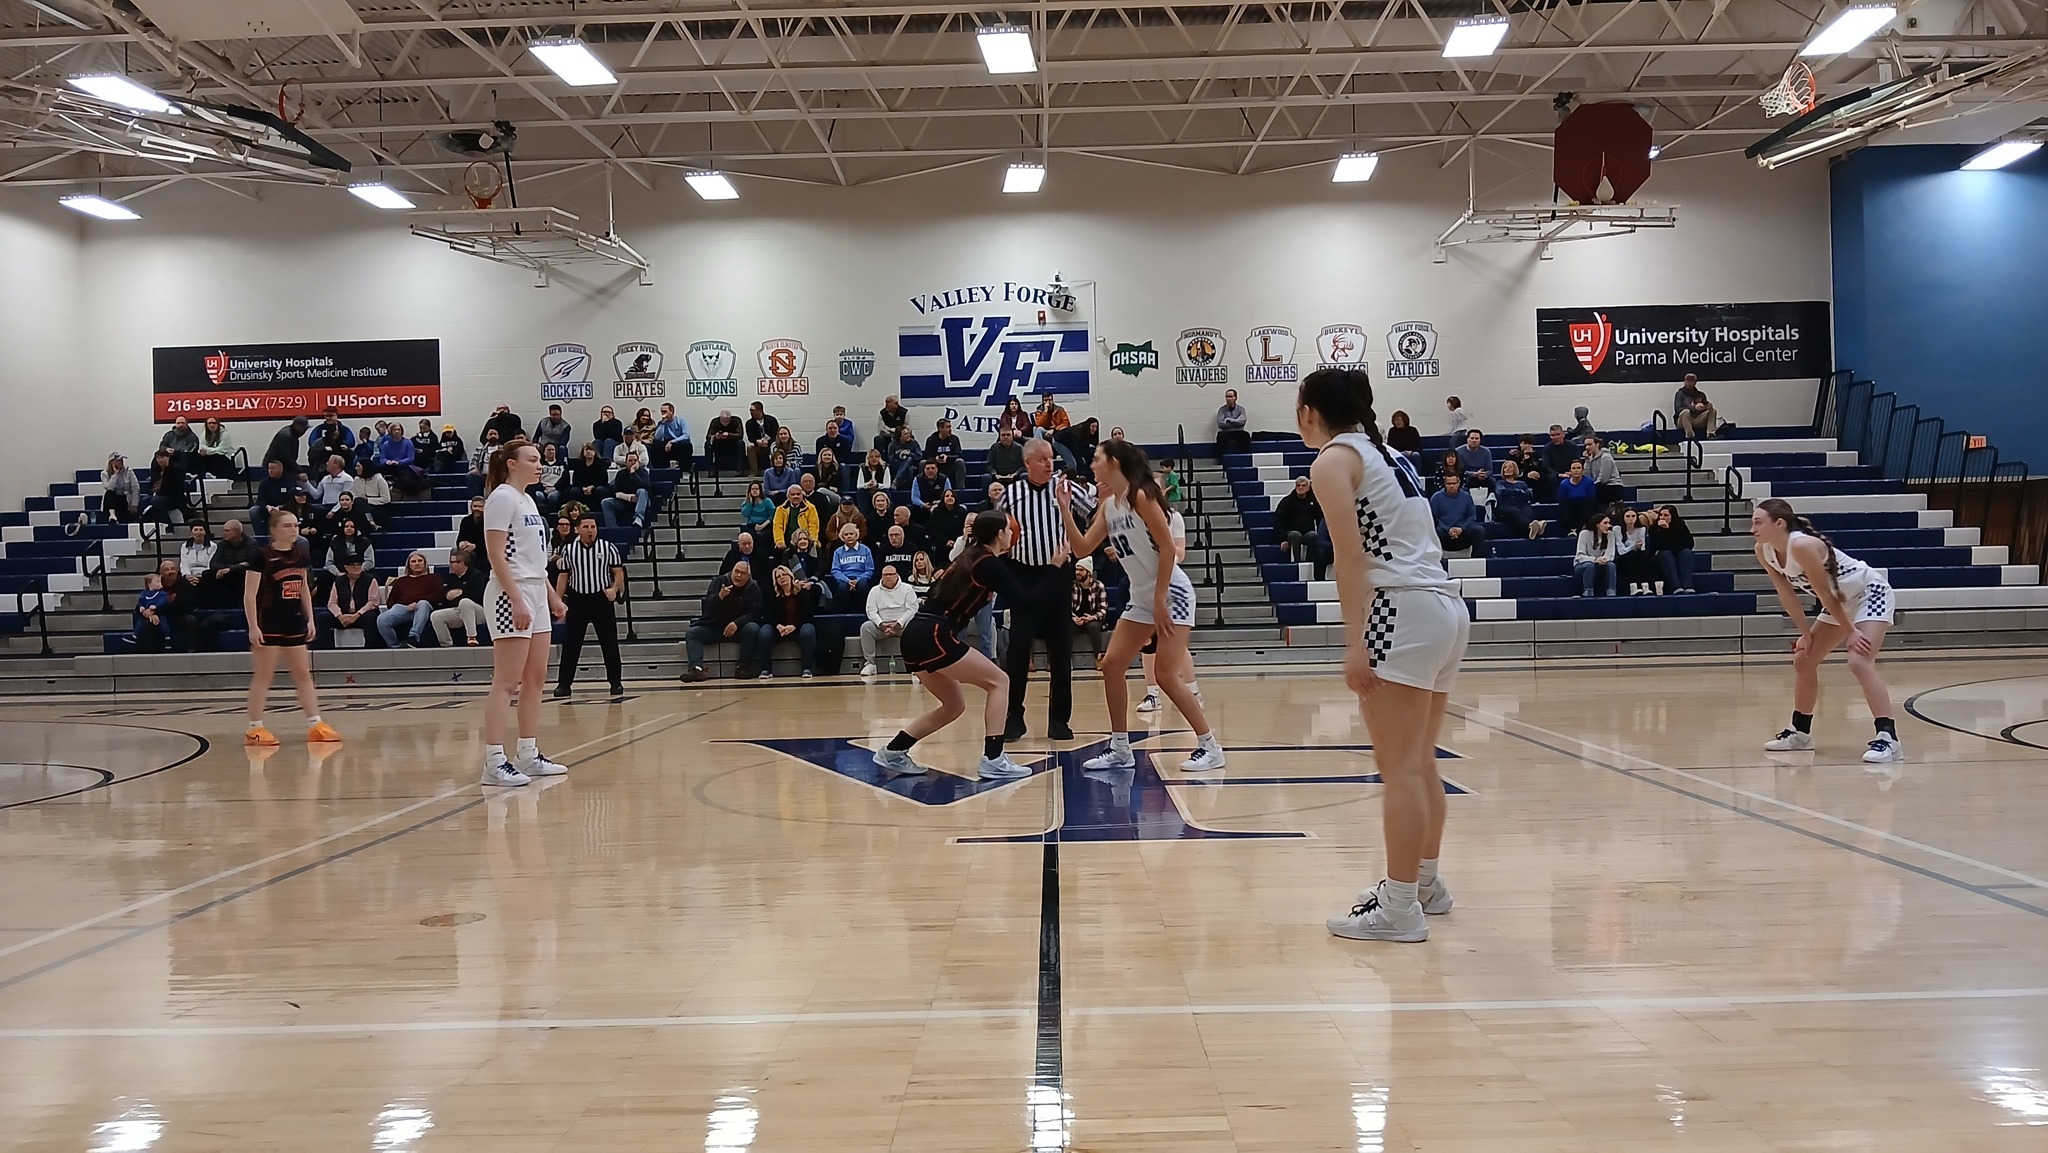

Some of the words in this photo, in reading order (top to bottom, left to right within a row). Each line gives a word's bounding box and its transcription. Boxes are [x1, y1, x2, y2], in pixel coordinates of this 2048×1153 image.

[910, 285, 995, 315] VALLEY
[1003, 282, 1076, 313] FORGE
[1254, 328, 1288, 337] LAKEWOOD
[1573, 328, 1591, 342] UH
[1615, 327, 1709, 347] University
[1714, 324, 1800, 344] Hospitals
[693, 343, 727, 352] WESTLAKE
[1615, 348, 1667, 366] Parma
[1673, 346, 1736, 364] Medical
[1742, 344, 1798, 363] Center
[206, 359, 218, 368] UH
[230, 358, 283, 370] University
[285, 356, 334, 369] Hospitals
[1112, 351, 1156, 366] OHSAA
[229, 370, 273, 382] Drusinsky
[275, 369, 305, 381] Sports
[307, 367, 348, 378] Medicine
[351, 366, 388, 377] Institute
[1178, 368, 1226, 382] INVADERS
[1248, 365, 1296, 380] RANGERS
[1388, 361, 1437, 376] PATRIOTS
[543, 383, 591, 398] ROCKETS
[615, 382, 664, 396] PIRATES
[688, 381, 736, 395] DEMONS
[760, 379, 806, 393] EAGLES
[167, 397, 261, 412] 216-983-PLAY
[265, 395, 307, 411] (7529)
[327, 393, 427, 409] UHSports.org
